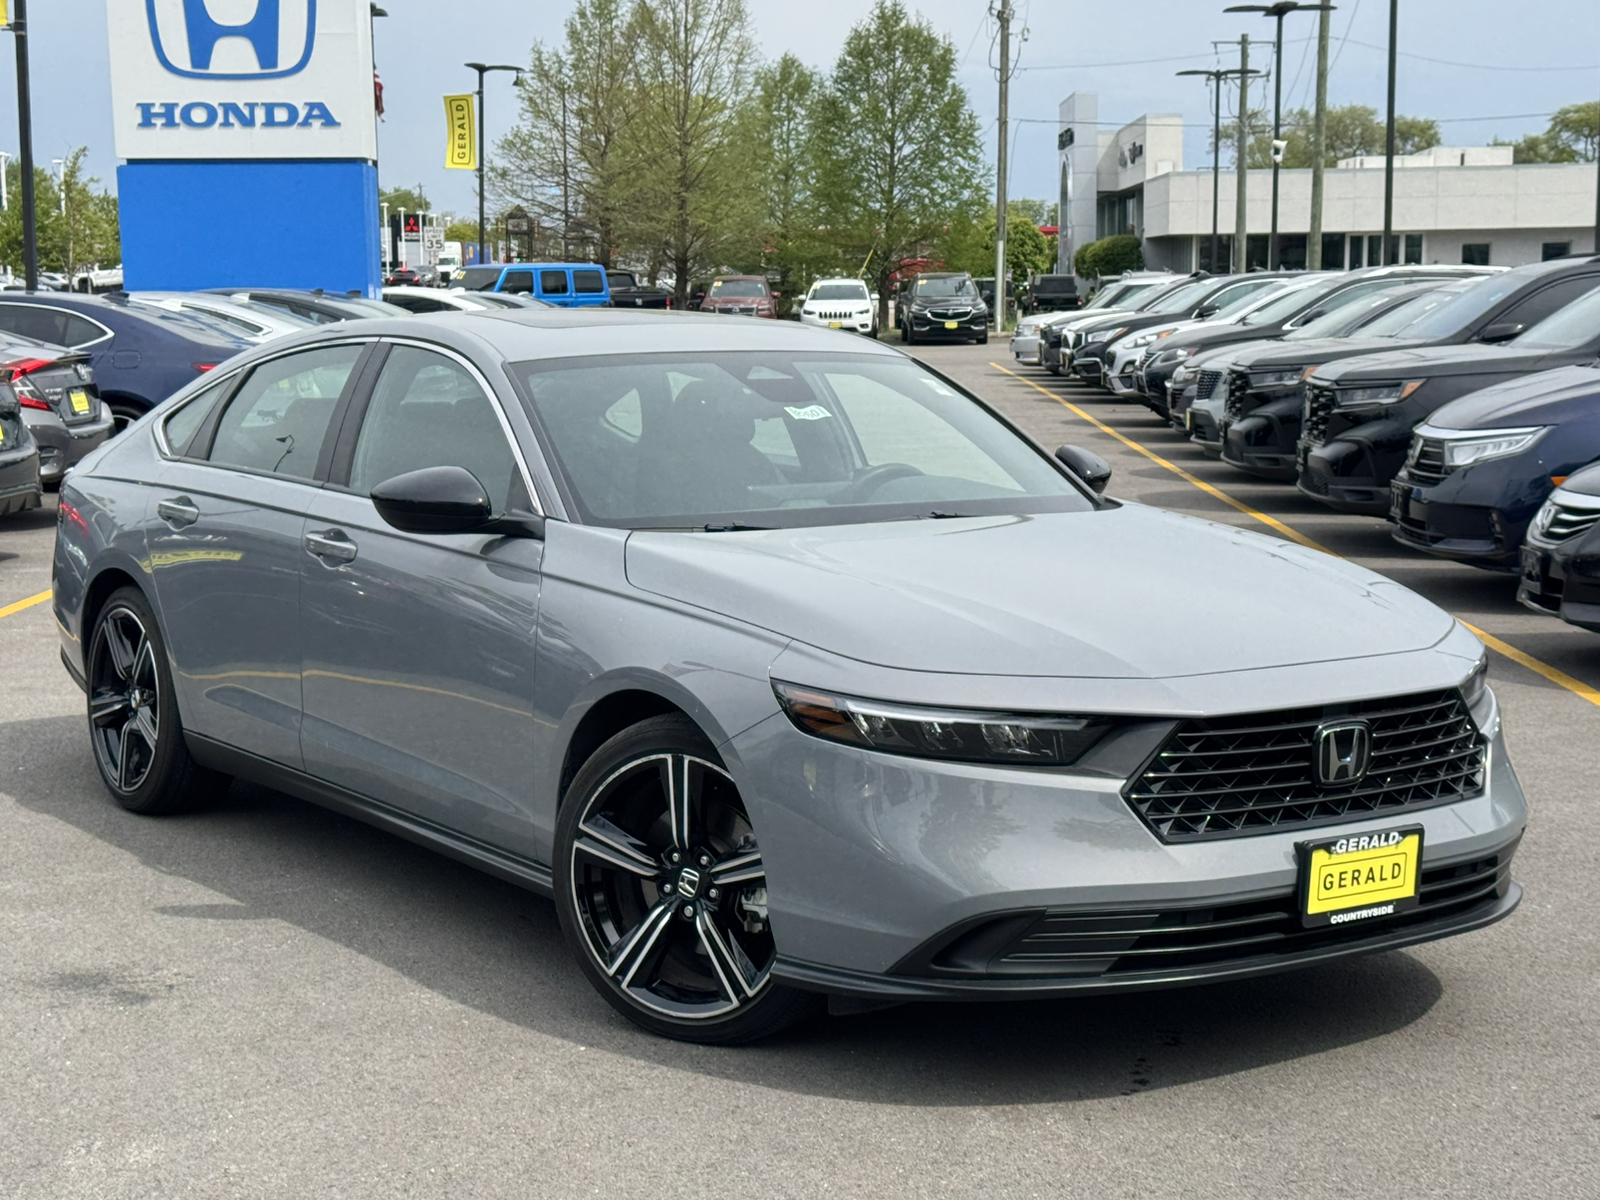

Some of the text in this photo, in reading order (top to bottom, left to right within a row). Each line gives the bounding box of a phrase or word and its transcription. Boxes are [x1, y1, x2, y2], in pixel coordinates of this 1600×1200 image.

[135, 102, 341, 128] HONDA
[455, 104, 466, 159] GERALD
[426, 240, 443, 249] 35
[1336, 831, 1400, 854] GERALD
[1323, 863, 1402, 891] GERALD
[1330, 905, 1394, 924] COUNTRYSIDE
